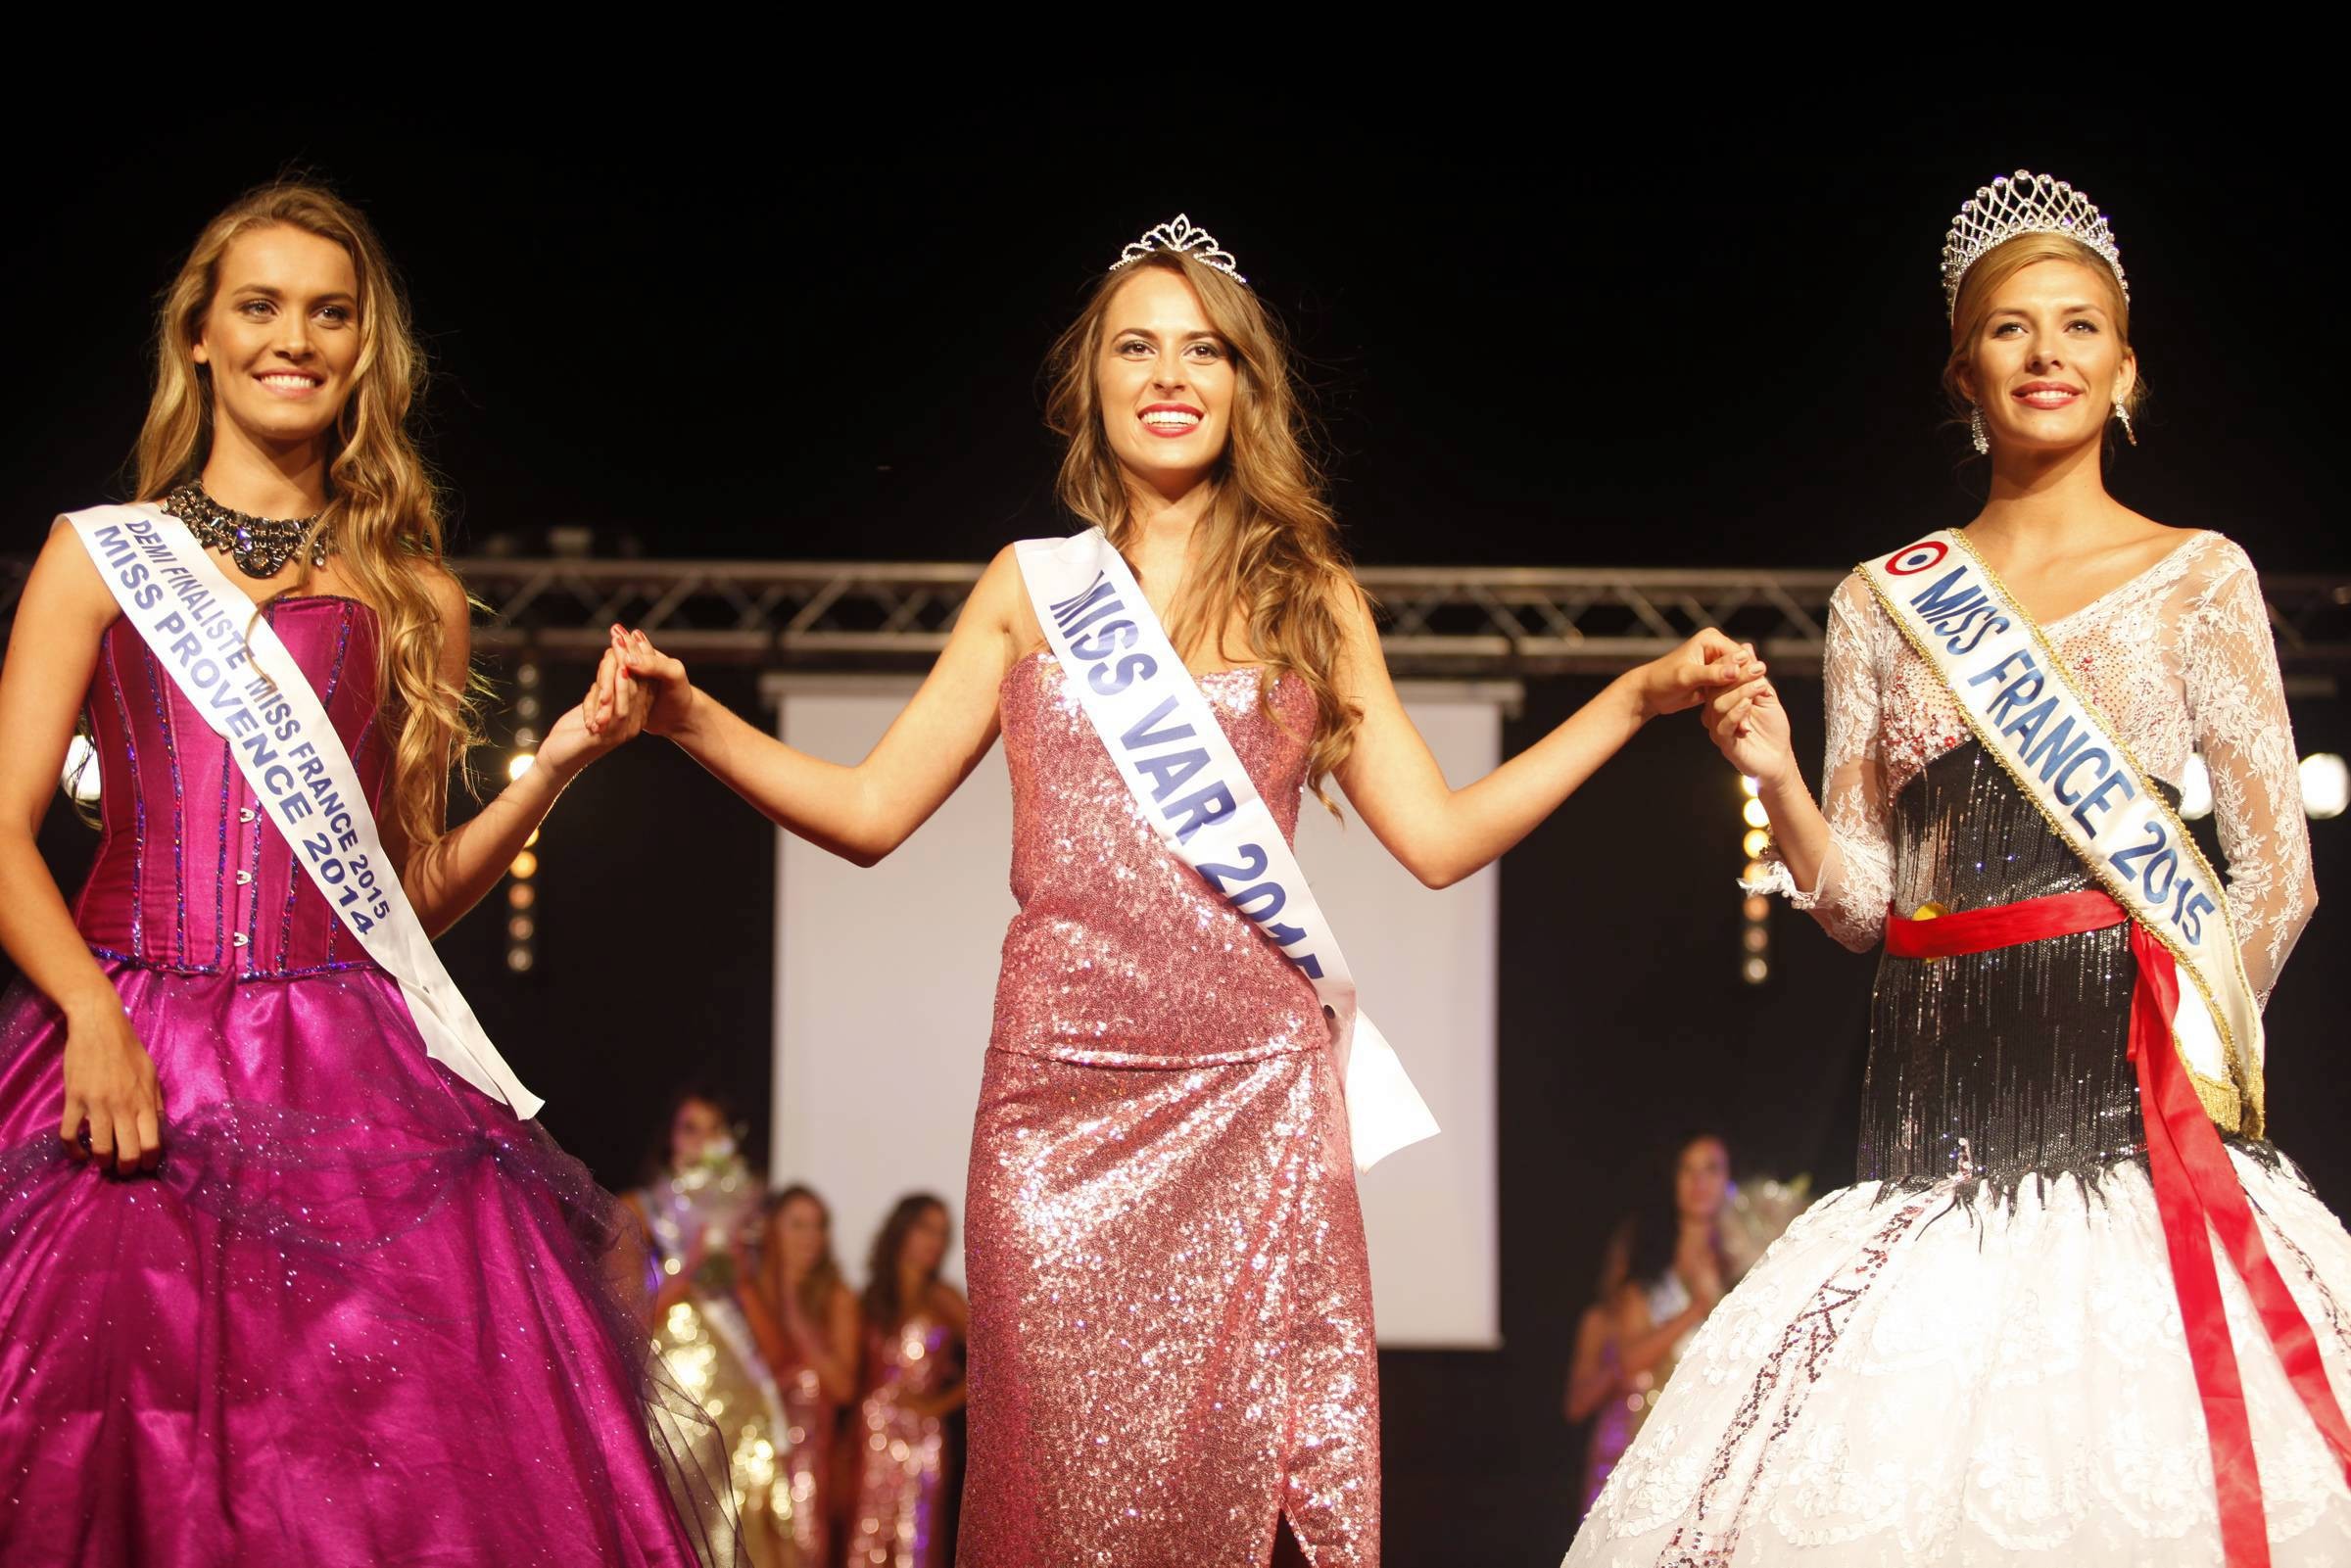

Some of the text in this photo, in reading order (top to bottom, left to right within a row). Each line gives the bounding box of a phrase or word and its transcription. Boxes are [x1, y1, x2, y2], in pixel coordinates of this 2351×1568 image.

[94, 525, 376, 936] MISS PROVENCE 2014
[124, 519, 391, 921] DEMI FINALISTE MISS FRANCE 2015
[1120, 694, 1236, 846] VAR
[1910, 565, 2216, 946] MISS FRANCE 2015
